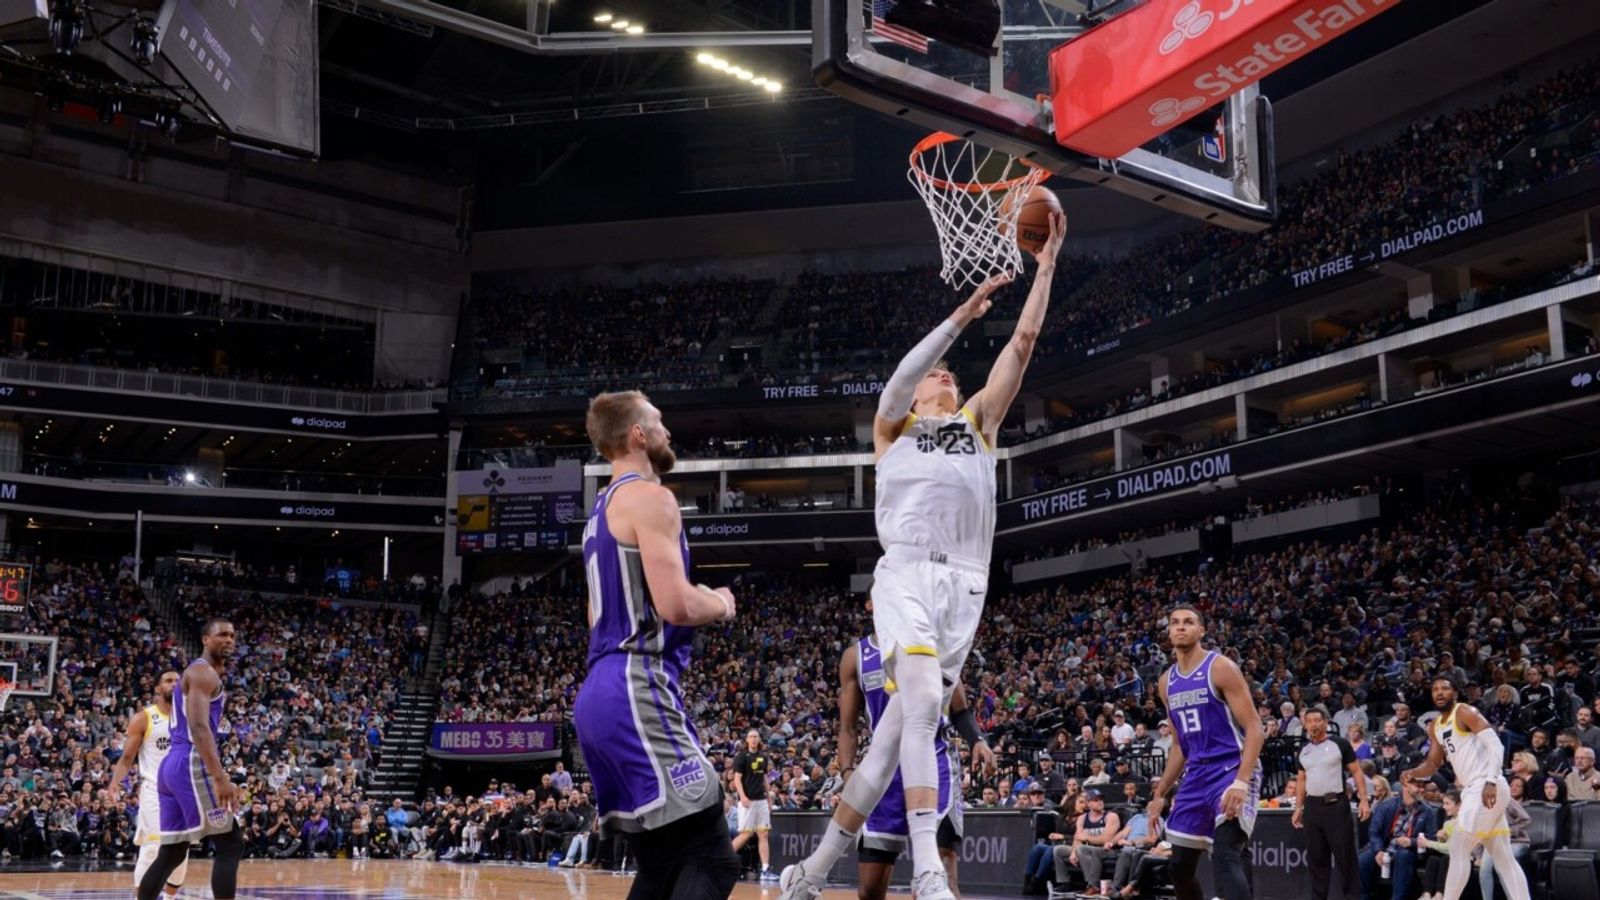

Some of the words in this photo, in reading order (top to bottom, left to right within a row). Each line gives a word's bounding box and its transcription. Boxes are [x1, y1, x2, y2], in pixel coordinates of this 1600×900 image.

[1292, 266, 1318, 289] TRY
[1319, 254, 1354, 281] FREE
[1381, 209, 1484, 259] DIALPAD.COM
[763, 386, 787, 399] TRY
[788, 384, 819, 398] FREE
[842, 381, 887, 395] DIALPA
[306, 416, 346, 429] dialpad
[941, 431, 977, 456] 23
[1, 483, 17, 500] M
[1022, 498, 1049, 521] TRY
[1051, 488, 1088, 515] FREE
[1117, 453, 1232, 499] DIALPAD.COM
[295, 504, 335, 517] dialpad
[705, 522, 749, 536] dialpad
[929, 551, 948, 565] UTAH
[1168, 687, 1209, 711] SAC
[1178, 708, 1202, 734] 13
[440, 730, 482, 749] MEBO
[484, 730, 504, 749] 35
[506, 731, 546, 749] 美寶
[673, 769, 705, 790] SAC
[781, 832, 809, 857] TRY
